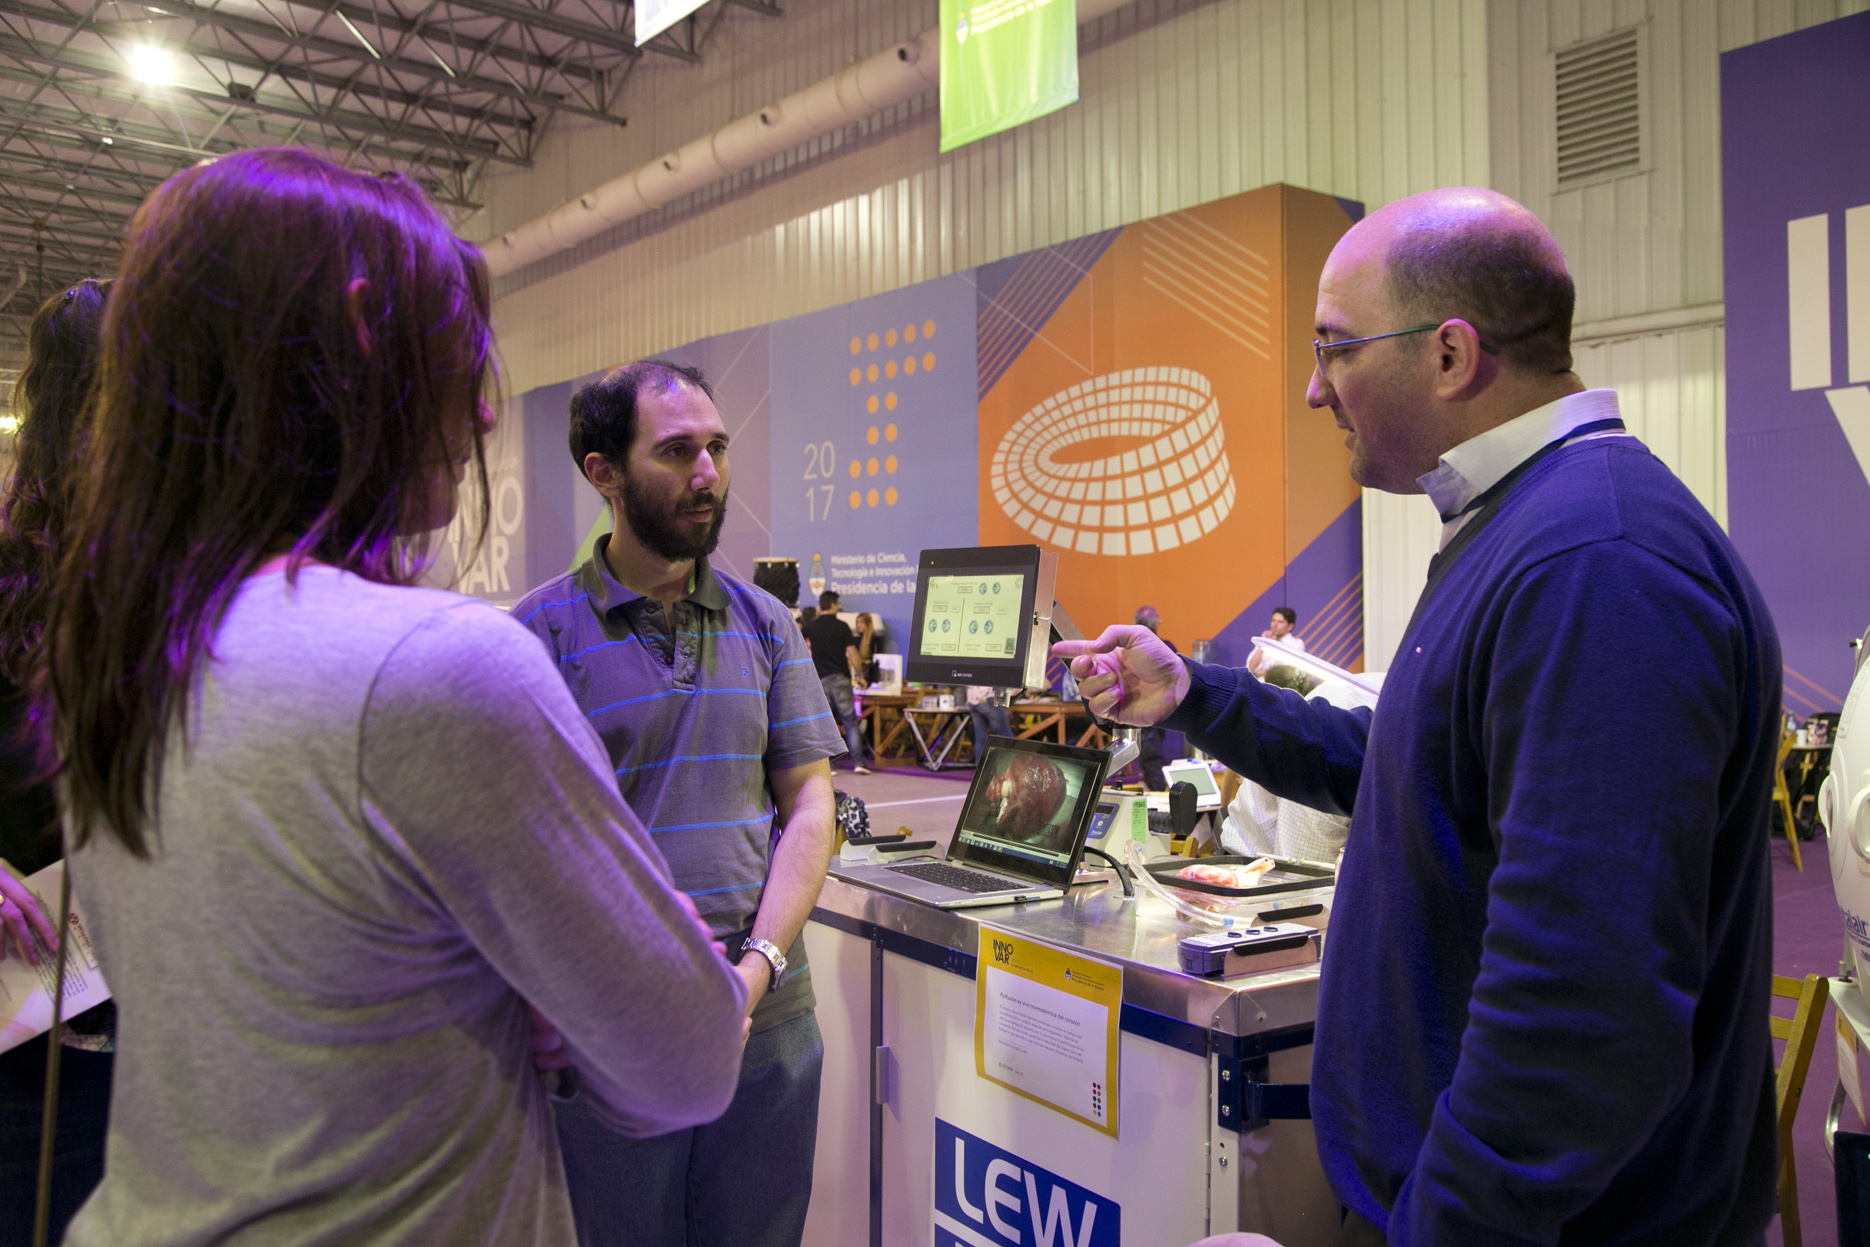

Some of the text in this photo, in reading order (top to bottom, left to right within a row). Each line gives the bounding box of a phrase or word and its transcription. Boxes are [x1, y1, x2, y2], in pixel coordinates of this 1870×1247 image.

[802, 441, 836, 481] 20
[805, 484, 835, 523] 17
[831, 552, 907, 565] Ministerio de Ciencia,
[831, 578, 917, 595] Presidencia de la
[992, 939, 1014, 956] INNO
[994, 950, 1010, 965] VAR
[954, 1136, 1098, 1247] LEW
